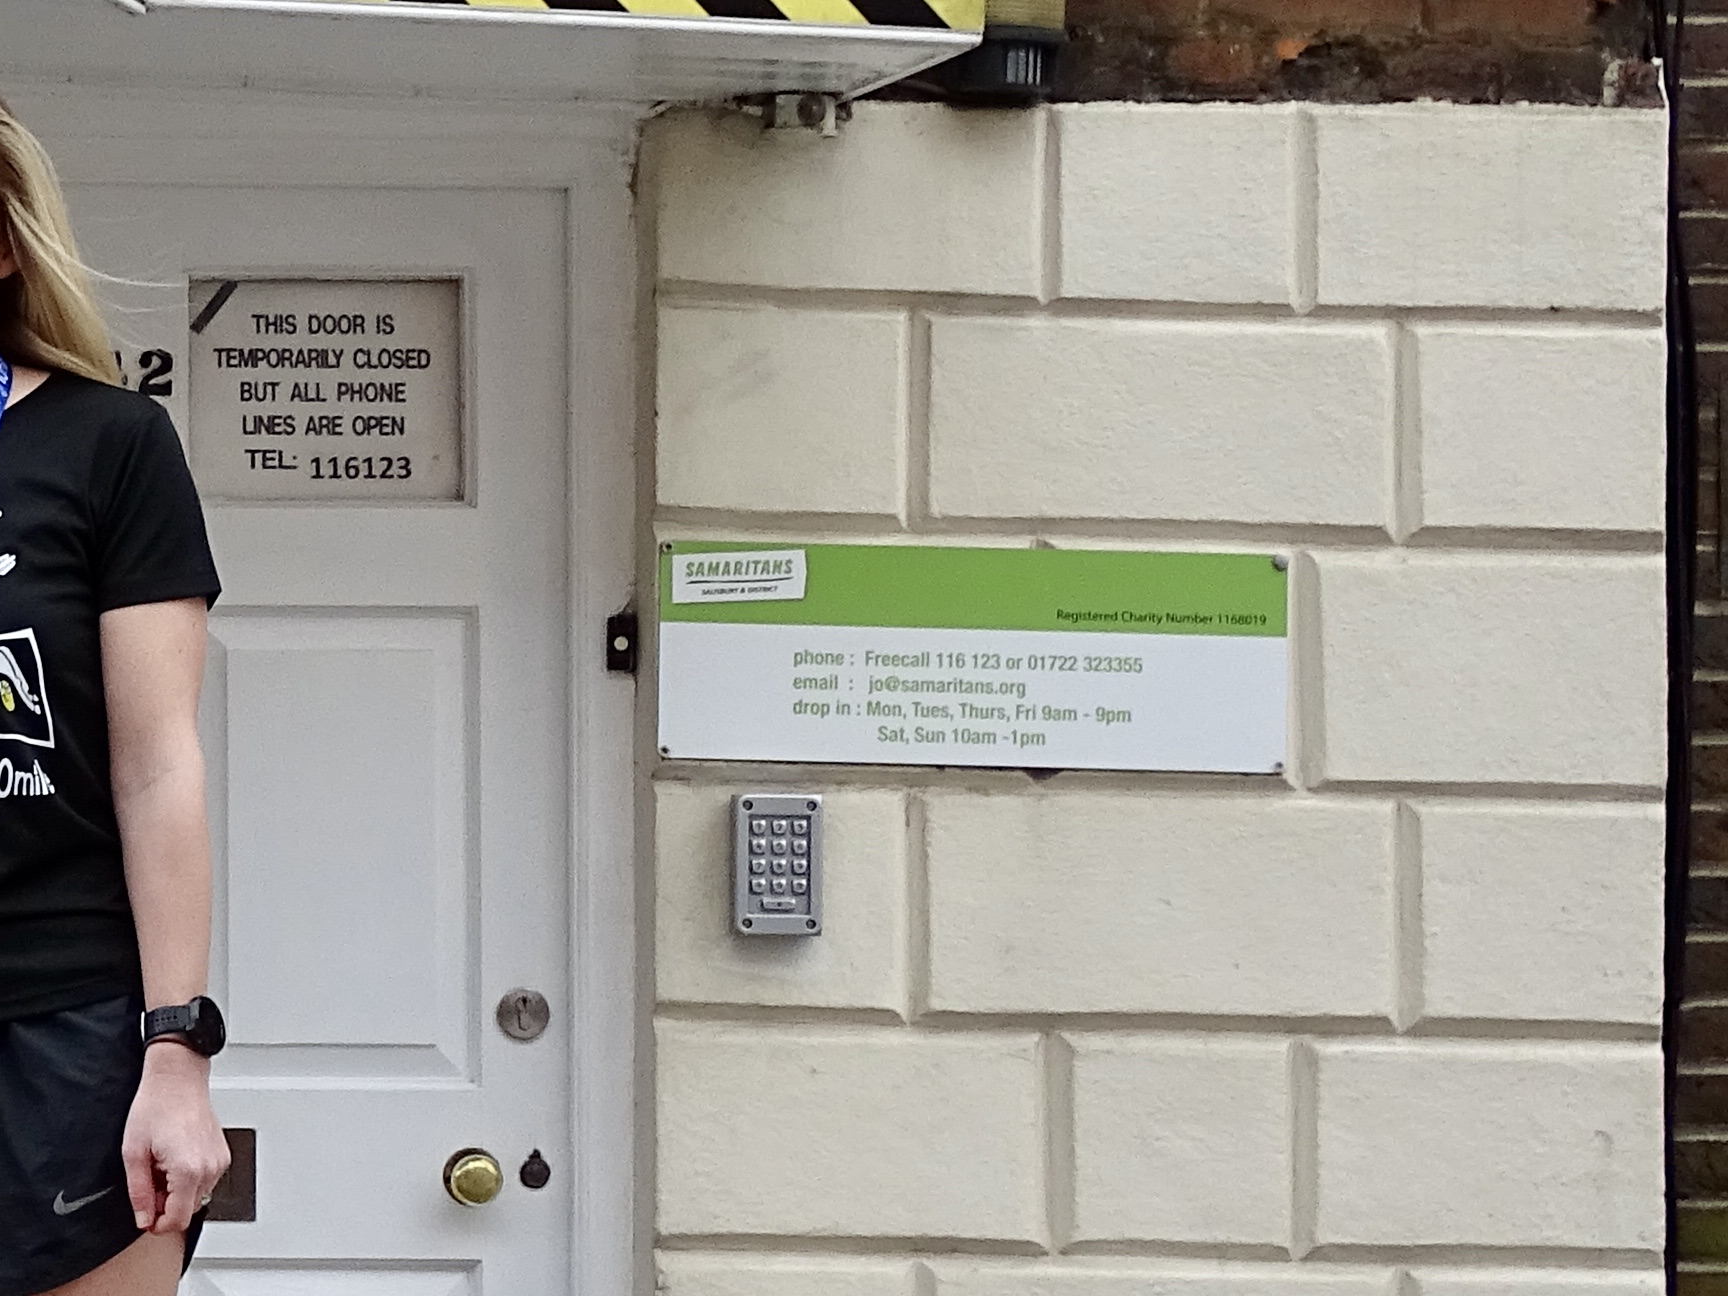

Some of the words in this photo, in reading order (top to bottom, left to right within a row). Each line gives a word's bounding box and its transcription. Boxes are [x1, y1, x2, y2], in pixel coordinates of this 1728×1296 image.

[251, 314, 296, 334] THIS
[308, 314, 365, 335] DOOR
[376, 314, 395, 335] IS
[213, 348, 344, 369] TEMPORARILY
[353, 348, 431, 369] CLOSED
[240, 381, 280, 402] BUT
[290, 382, 327, 402] ALL
[337, 382, 407, 403] PHONE
[242, 415, 295, 435] LINES
[305, 415, 343, 436] ARE
[352, 415, 405, 436] OPEN
[310, 457, 412, 479] 116123
[684, 559, 793, 577] SAMARITANS
[1056, 608, 1118, 623] Registered
[1121, 610, 1163, 625] Charity
[1166, 611, 1213, 624] Number
[793, 649, 844, 668] phone
[865, 650, 930, 668] Freecall
[936, 653, 966, 668] 116
[972, 653, 1000, 670] 123
[1006, 657, 1022, 671] or
[1027, 654, 1077, 672] 01722
[1082, 656, 1143, 674] 323355
[793, 674, 839, 691] email
[867, 674, 1026, 699] jo@samaritans.org
[793, 699, 830, 718] drop
[836, 700, 851, 716] in
[866, 701, 907, 719] Mon,
[912, 702, 955, 722] Tues,
[958, 703, 1011, 722] Thurs,
[1015, 705, 1037, 721] Fri
[1041, 705, 1077, 722] 9am
[1095, 706, 1132, 725] 9pm
[877, 725, 909, 744] Sat,
[914, 726, 946, 743] Sun
[952, 727, 996, 745] 10am
